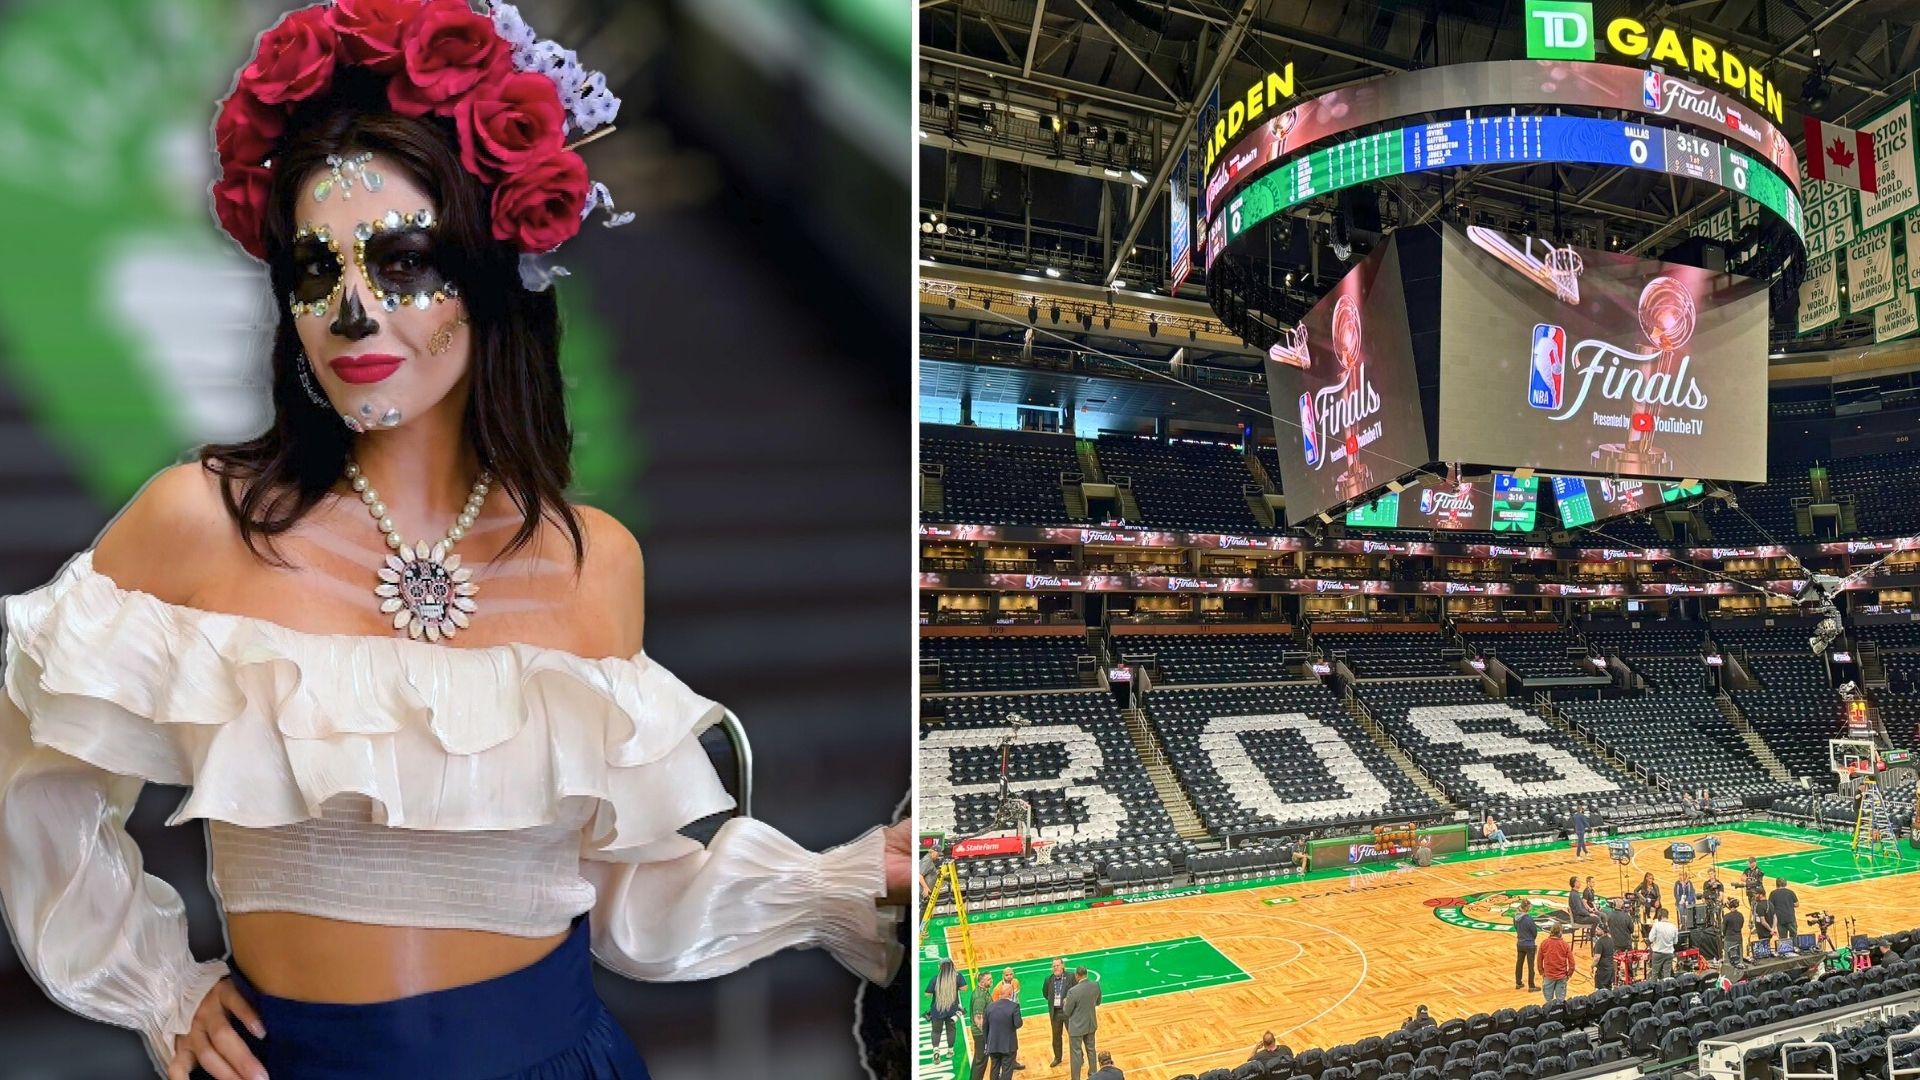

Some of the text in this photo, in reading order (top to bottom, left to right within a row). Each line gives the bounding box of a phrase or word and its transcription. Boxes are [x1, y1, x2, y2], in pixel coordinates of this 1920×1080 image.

[1532, 11, 1783, 124] TD GARDEN
[1654, 79, 1726, 124] Finals
[1624, 126, 1649, 139] DALLAS
[1629, 139, 1648, 164] 0
[1677, 135, 1710, 158] 3:16
[1876, 133, 1907, 161] LTICS
[1877, 170, 1896, 187] 2008
[1874, 180, 1903, 201] WORLD
[1828, 194, 1849, 220] 31
[1866, 187, 1913, 217] CHAMPIONS
[1713, 210, 1729, 234] 14
[1835, 223, 1846, 244] 5
[1852, 236, 1887, 260] CELTICS
[1806, 261, 1832, 282] ELTICS
[1858, 274, 1883, 290] WORLD
[1863, 265, 1877, 278] 1974
[1852, 281, 1891, 303] CHAMPIONS
[1801, 302, 1837, 324] CHAMPIONS
[1807, 296, 1829, 312] WORLD
[1884, 307, 1907, 323] WORLD
[1878, 313, 1915, 335] CHAMPIONS
[1548, 339, 1708, 421] Finals
[1533, 388, 1549, 404] NBA
[1314, 361, 1381, 471] Finals
[1593, 412, 1622, 428] Presented
[1623, 415, 1631, 430] by
[1426, 491, 1475, 515] Finals
[1508, 493, 1523, 501] 3:16
[1088, 531, 1115, 543] Finals
[1032, 576, 1061, 588] Finals
